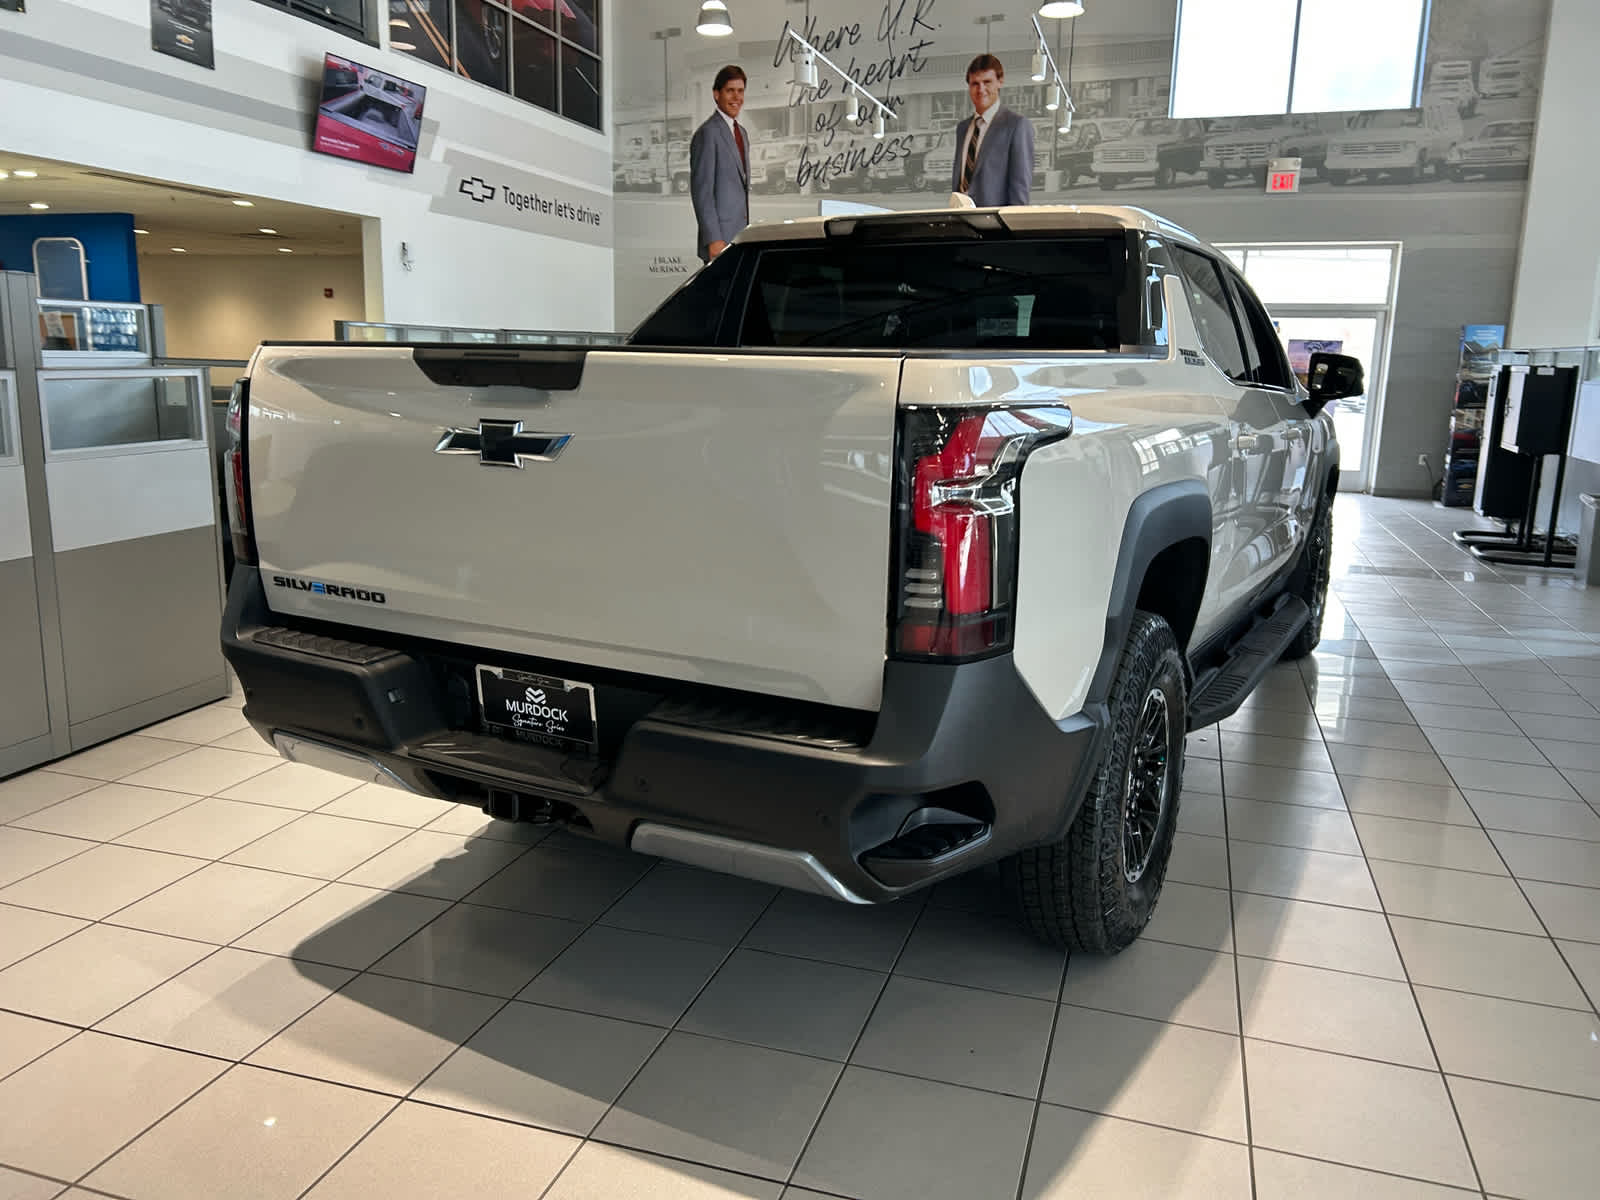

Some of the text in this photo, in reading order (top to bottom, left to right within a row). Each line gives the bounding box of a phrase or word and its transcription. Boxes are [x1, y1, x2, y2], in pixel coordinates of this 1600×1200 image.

[842, 40, 935, 94] heart
[815, 104, 842, 147] of
[797, 135, 914, 187] business
[1272, 173, 1297, 190] EXIT
[502, 185, 601, 226] Together let's drive
[272, 575, 387, 604] SILVERADO
[505, 698, 569, 723] MURDOCK
